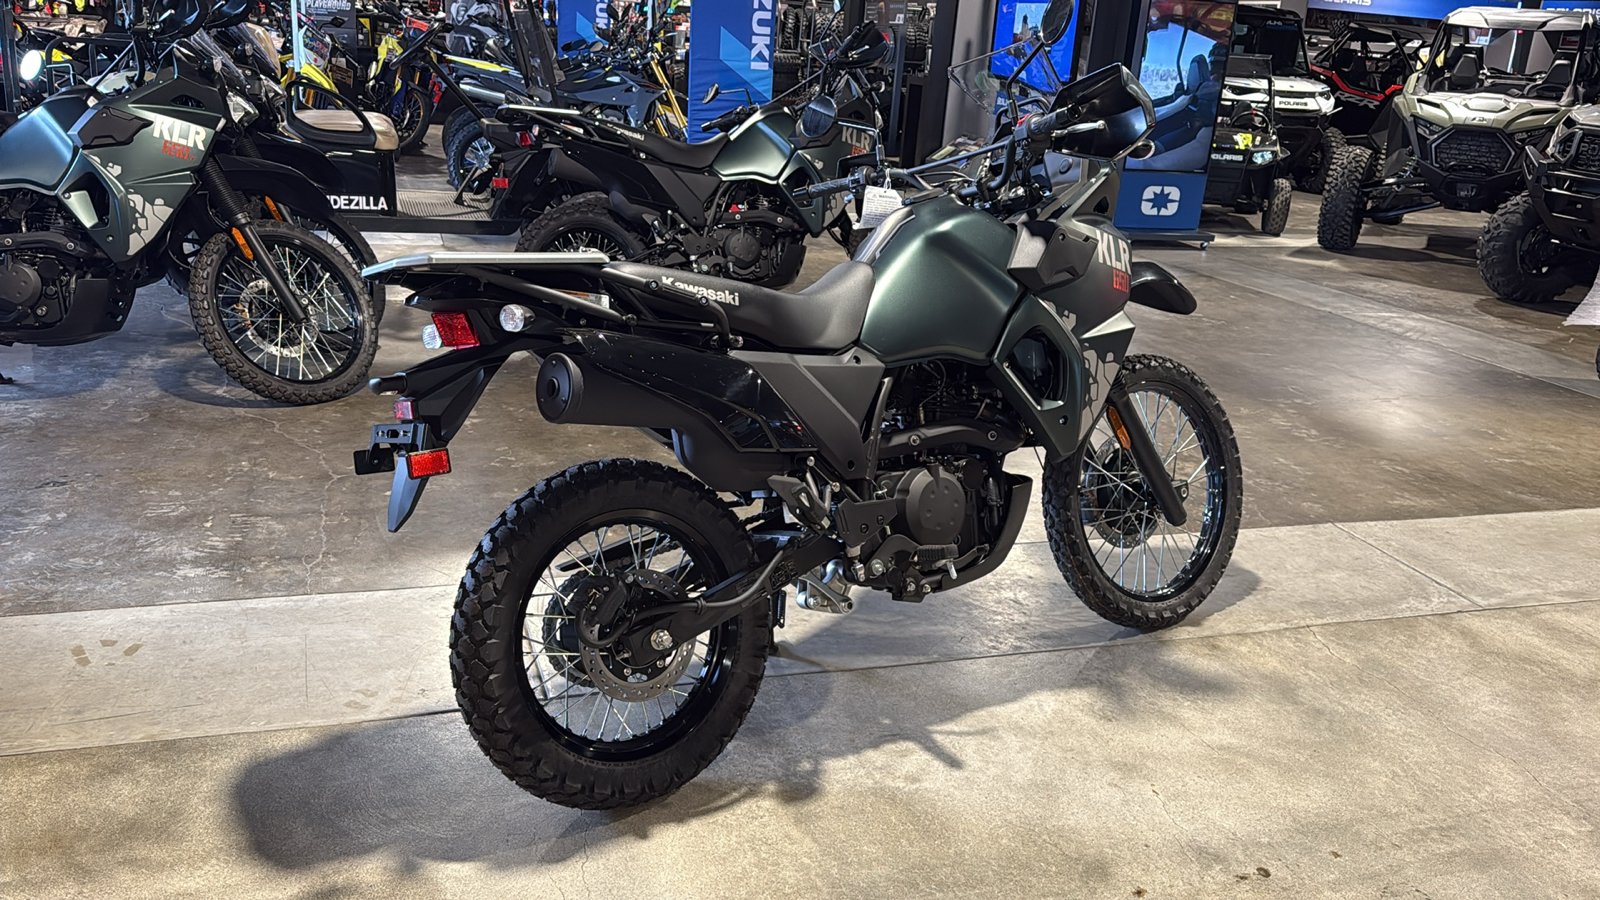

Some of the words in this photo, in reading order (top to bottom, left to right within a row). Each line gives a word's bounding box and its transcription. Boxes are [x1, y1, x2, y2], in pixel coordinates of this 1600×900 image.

[1334, 91, 1381, 109] RZR
[153, 114, 206, 151] KLR
[841, 126, 870, 152] KLR
[162, 140, 191, 160] 650
[326, 195, 388, 210] DEZILLA
[1095, 229, 1132, 275] KLR
[661, 275, 740, 307] Kawasaki
[1112, 268, 1130, 293] 650
